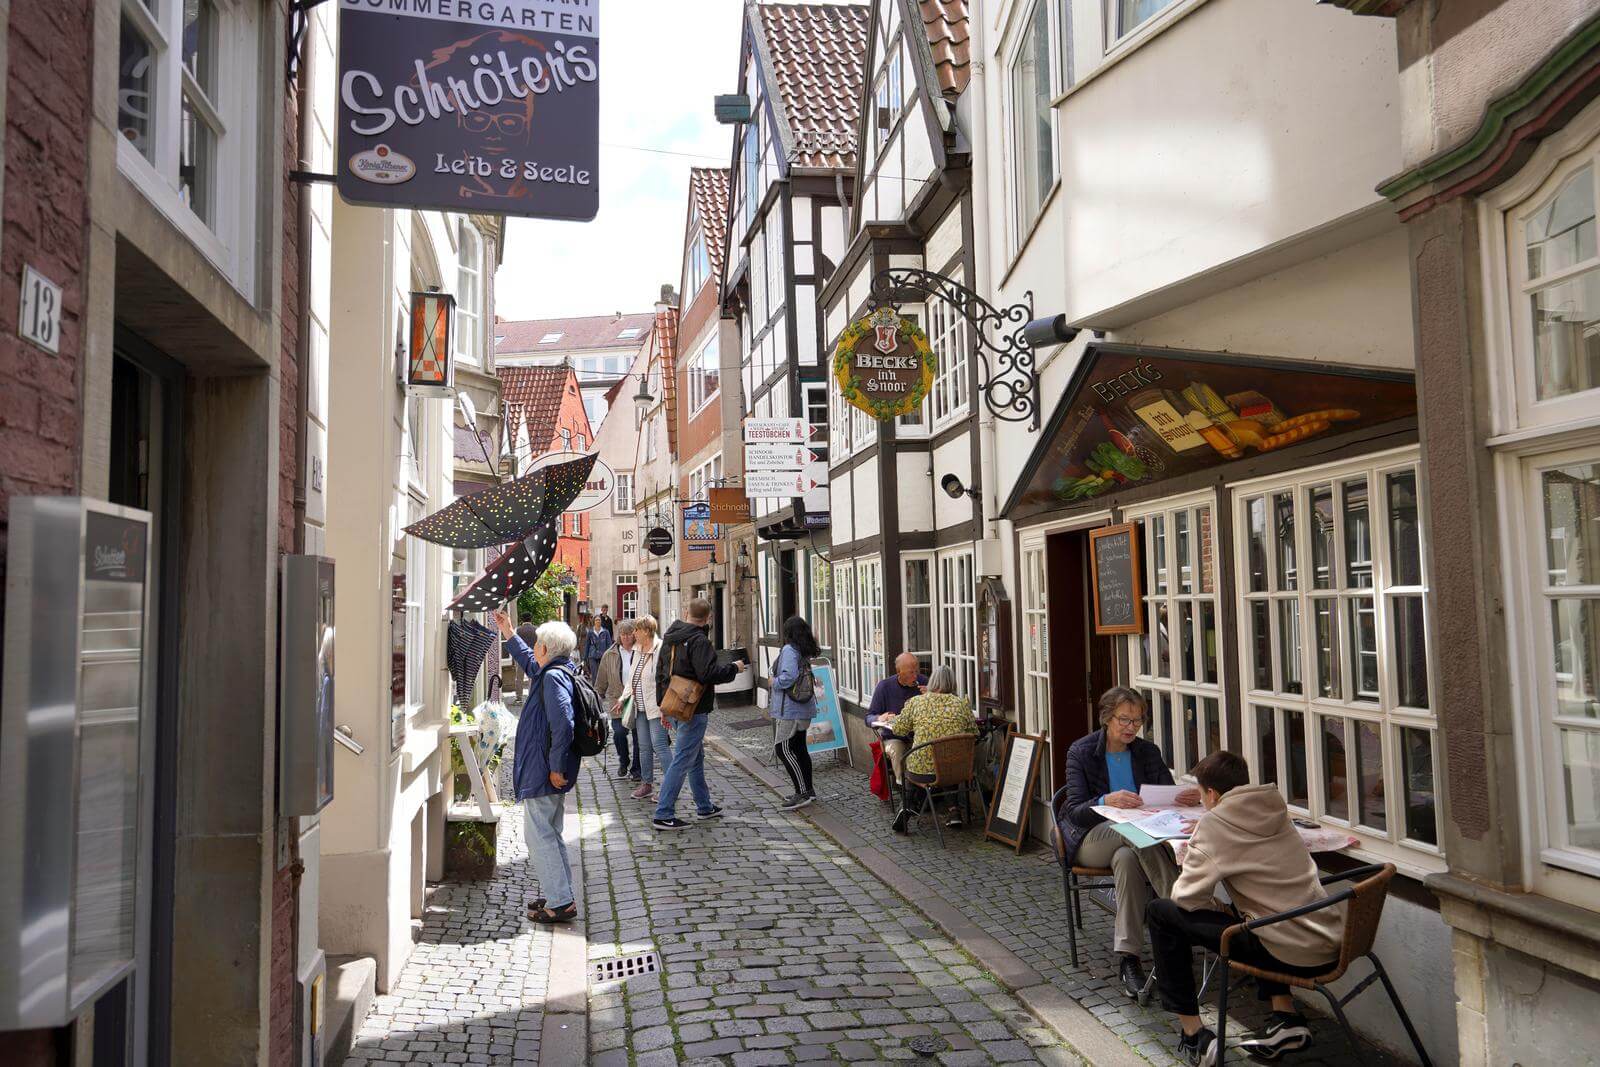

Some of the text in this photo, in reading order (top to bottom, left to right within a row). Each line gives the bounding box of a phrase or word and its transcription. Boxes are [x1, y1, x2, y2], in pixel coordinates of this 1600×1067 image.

[346, 0, 593, 32] MMERGARTEN
[341, 40, 597, 136] Schröter's
[434, 152, 590, 185] Leib & Seele
[31, 280, 54, 343] 13
[867, 378, 907, 392] Snoor
[748, 430, 790, 438] TEESTÜBCHEN
[711, 503, 750, 511] Stichnoth
